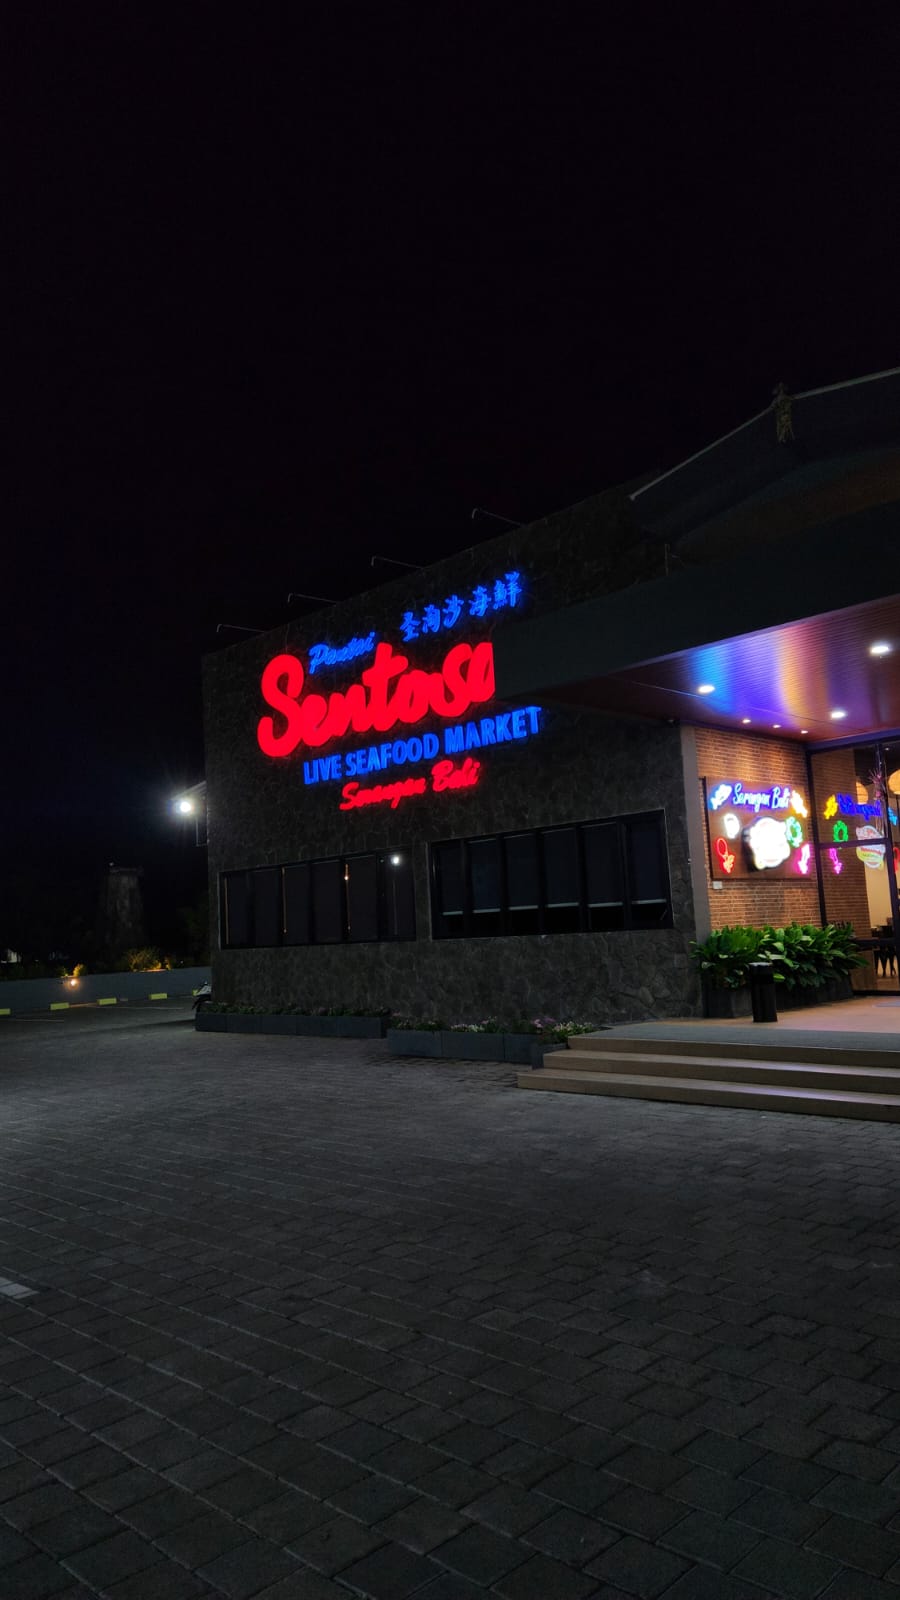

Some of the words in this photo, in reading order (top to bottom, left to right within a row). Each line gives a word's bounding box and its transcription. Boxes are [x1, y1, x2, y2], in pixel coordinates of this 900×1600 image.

[257, 641, 496, 758] Sentosa
[303, 754, 342, 785] LIVE
[345, 733, 440, 777] SEAFOOD
[445, 706, 542, 754] MARKET
[431, 757, 481, 792] Bali
